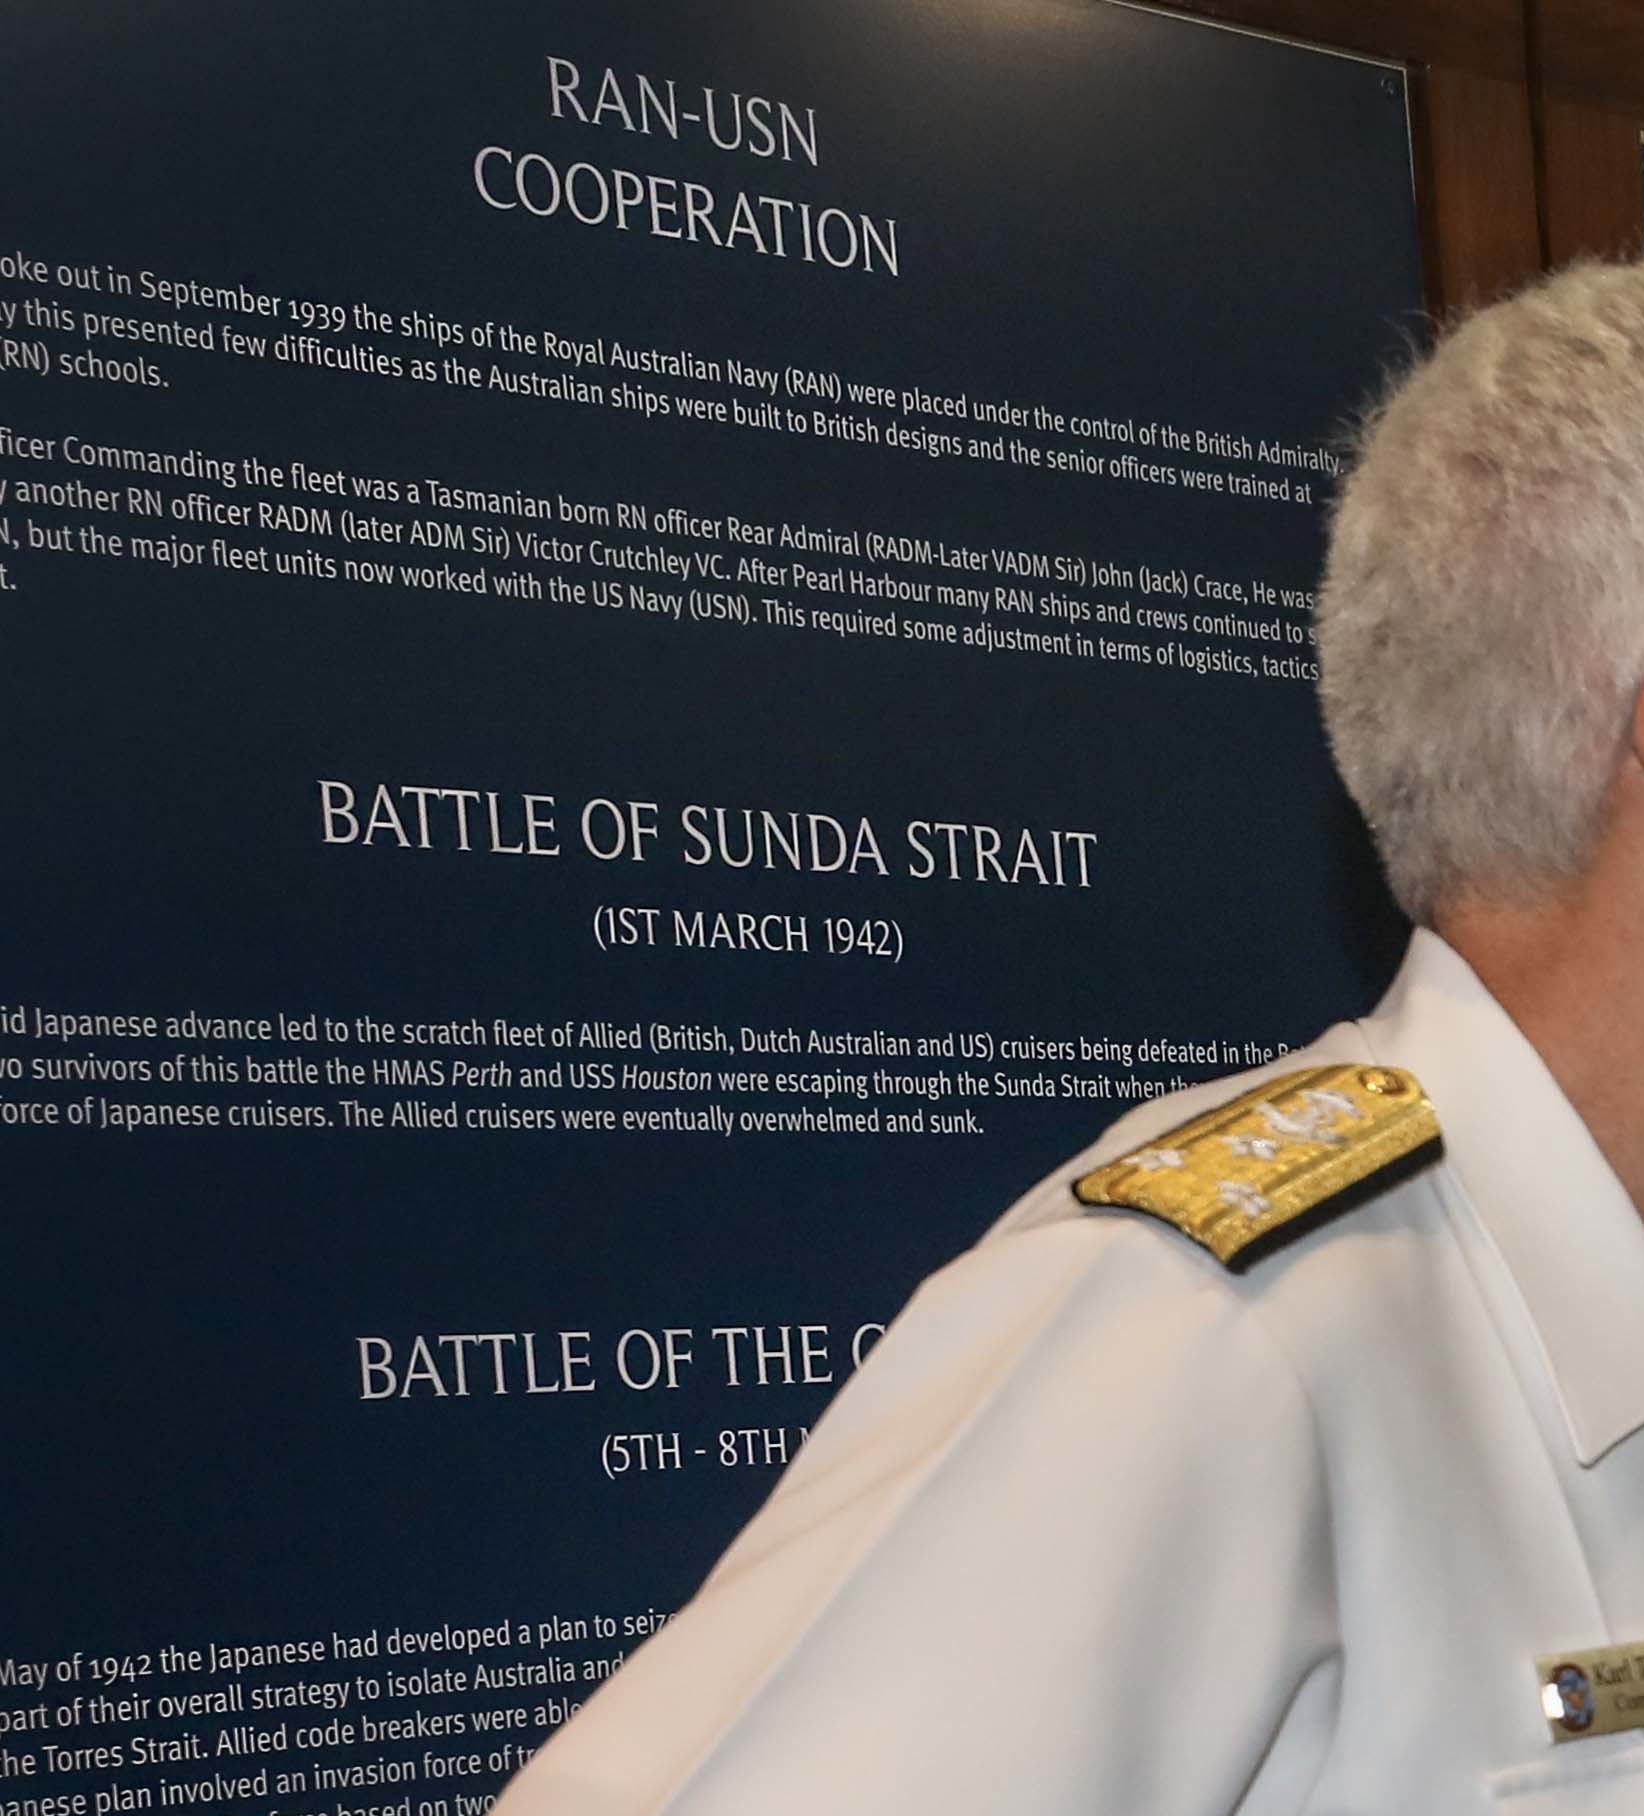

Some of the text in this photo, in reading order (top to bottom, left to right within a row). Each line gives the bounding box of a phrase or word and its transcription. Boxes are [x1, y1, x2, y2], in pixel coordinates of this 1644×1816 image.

[548, 56, 817, 167] RAN-USN
[475, 146, 898, 276] COOPERATION
[57, 265, 101, 292] out
[108, 265, 131, 295] in
[140, 271, 281, 316] September
[289, 300, 345, 332] 1939
[353, 303, 392, 333] the
[401, 310, 464, 346] ships
[472, 322, 494, 348] of
[499, 325, 536, 355] the
[544, 331, 604, 366] Royal
[611, 342, 720, 381] Australian
[728, 359, 778, 395] Navy
[785, 367, 841, 404] (RAN)
[848, 384, 895, 408] were
[903, 387, 967, 418] placed
[974, 400, 1029, 427] under
[1034, 405, 1064, 433] the
[1071, 417, 1134, 444] control
[1139, 422, 1157, 445] of
[1161, 425, 1190, 451] the
[1196, 430, 1252, 461] British
[1257, 439, 1345, 476] Admiralty.
[60, 349, 168, 387] schools.
[318, 780, 1097, 887] BATTLE OF SUNDA STRAIT
[594, 906, 902, 963] (1ST MARCH 1942)
[0, 1095, 983, 1137] orce of Japanese cruisers. The Allied cruisers were eventually overwhelmed and sunk.
[356, 1331, 595, 1399] BATTLE
[617, 1328, 692, 1390] OF
[712, 1325, 832, 1386] THE
[603, 1432, 681, 1480] (5TH
[720, 1428, 787, 1466] 8TH
[0, 1659, 48, 1691] May
[57, 1652, 82, 1682] of
[90, 1654, 152, 1685] 1942
[160, 1644, 201, 1674] the
[210, 1641, 324, 1674] Japanese
[333, 1629, 378, 1659] had
[387, 1619, 510, 1655] developed
[519, 1624, 530, 1645] a
[539, 1615, 587, 1649] plan
[594, 1615, 616, 1639] to
